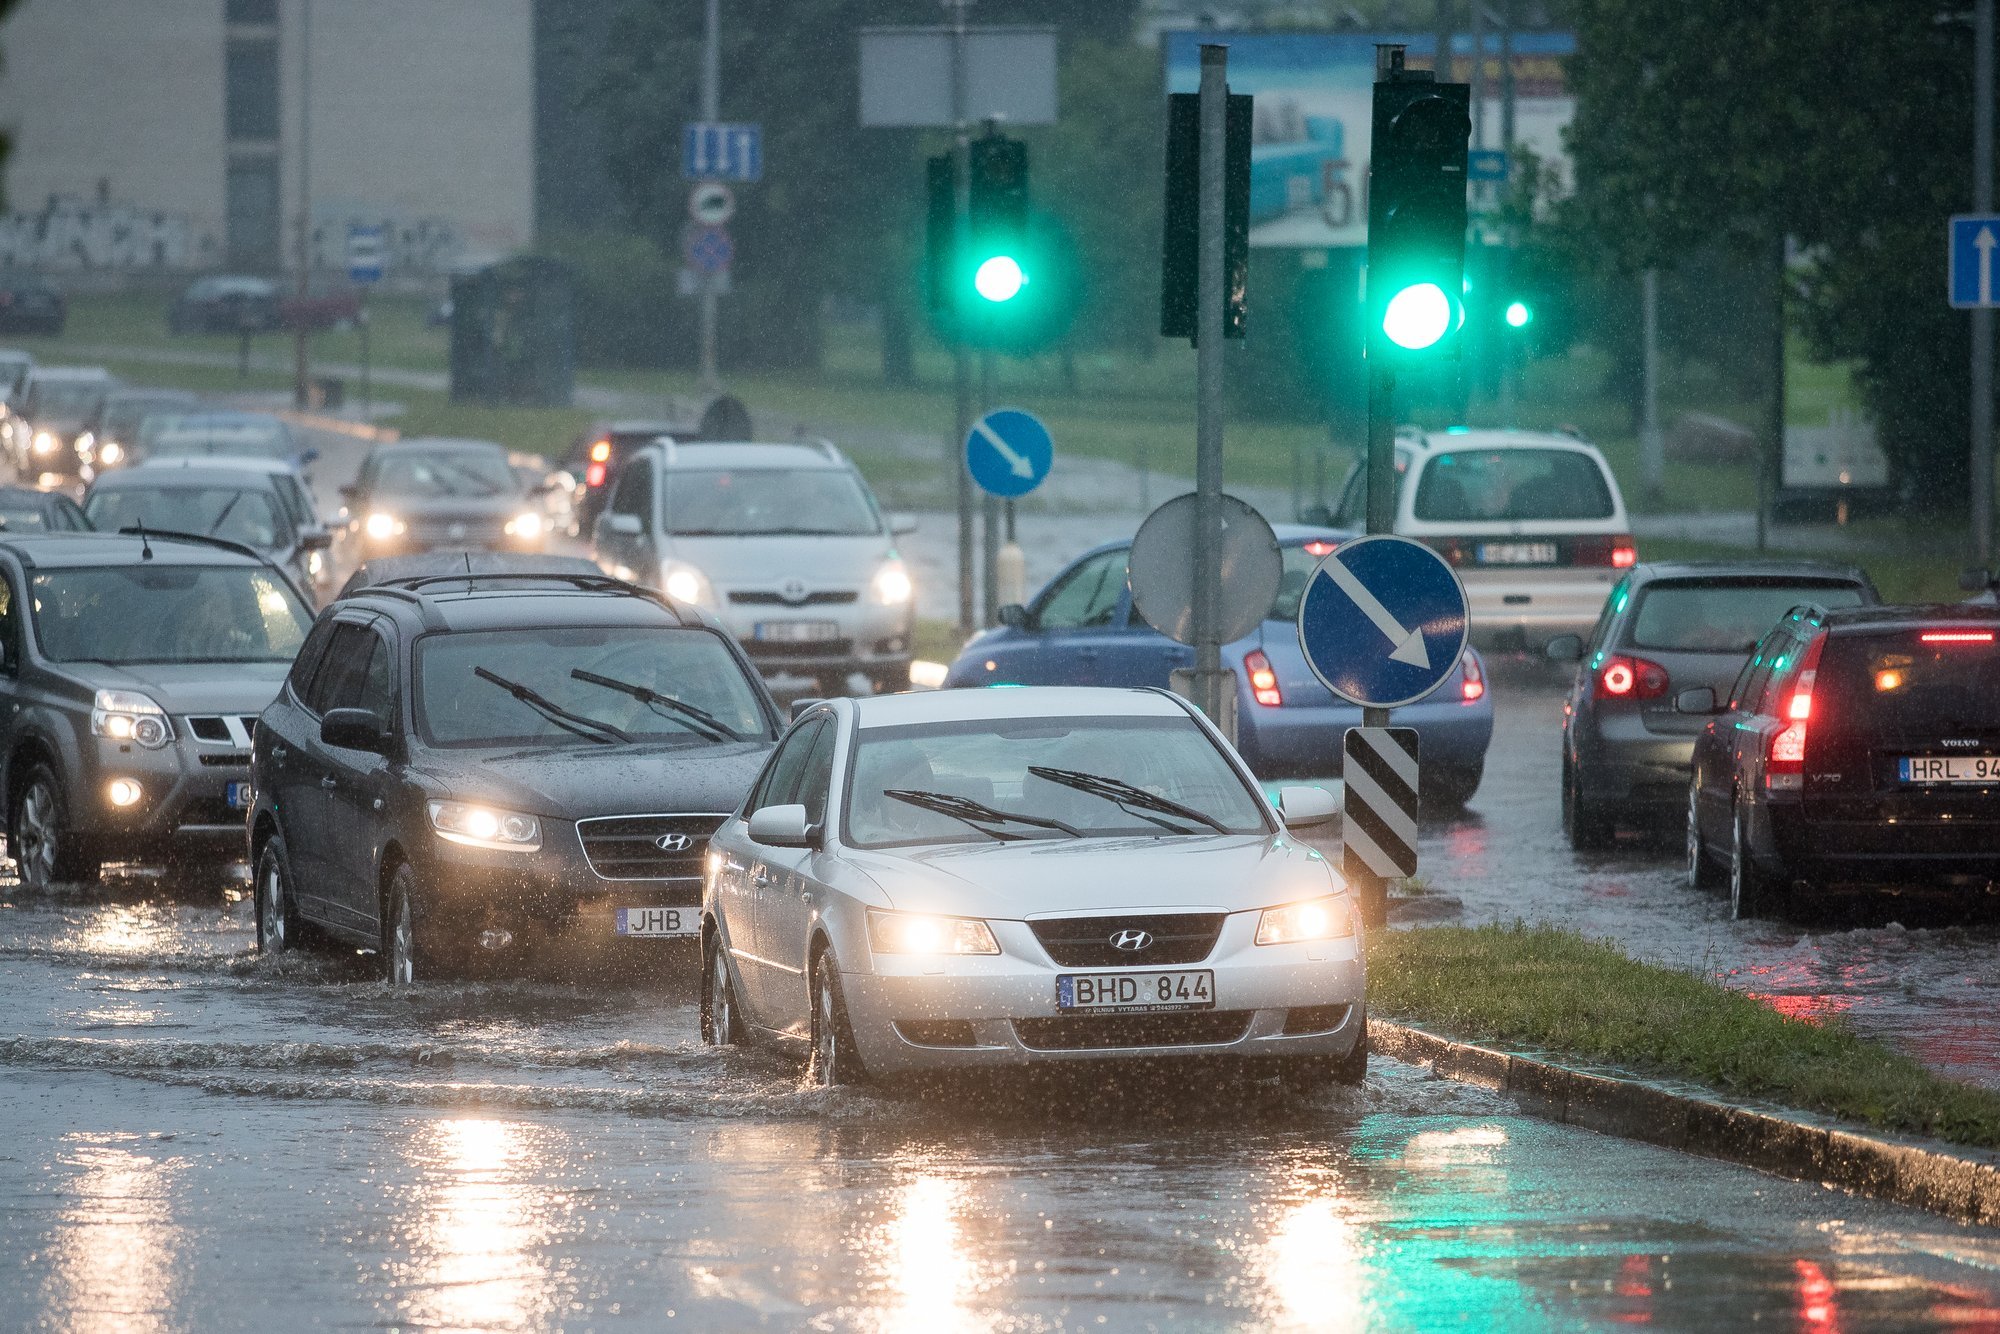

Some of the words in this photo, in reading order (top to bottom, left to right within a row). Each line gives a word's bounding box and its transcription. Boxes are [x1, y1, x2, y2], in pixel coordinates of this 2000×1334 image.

[1941, 739, 1979, 747] VOLVO
[1812, 774, 1842, 783] V70
[1913, 759, 1960, 779] HRL
[631, 909, 681, 932] JHB
[1077, 977, 1137, 1003] BHD
[1157, 975, 1208, 1001] 844
